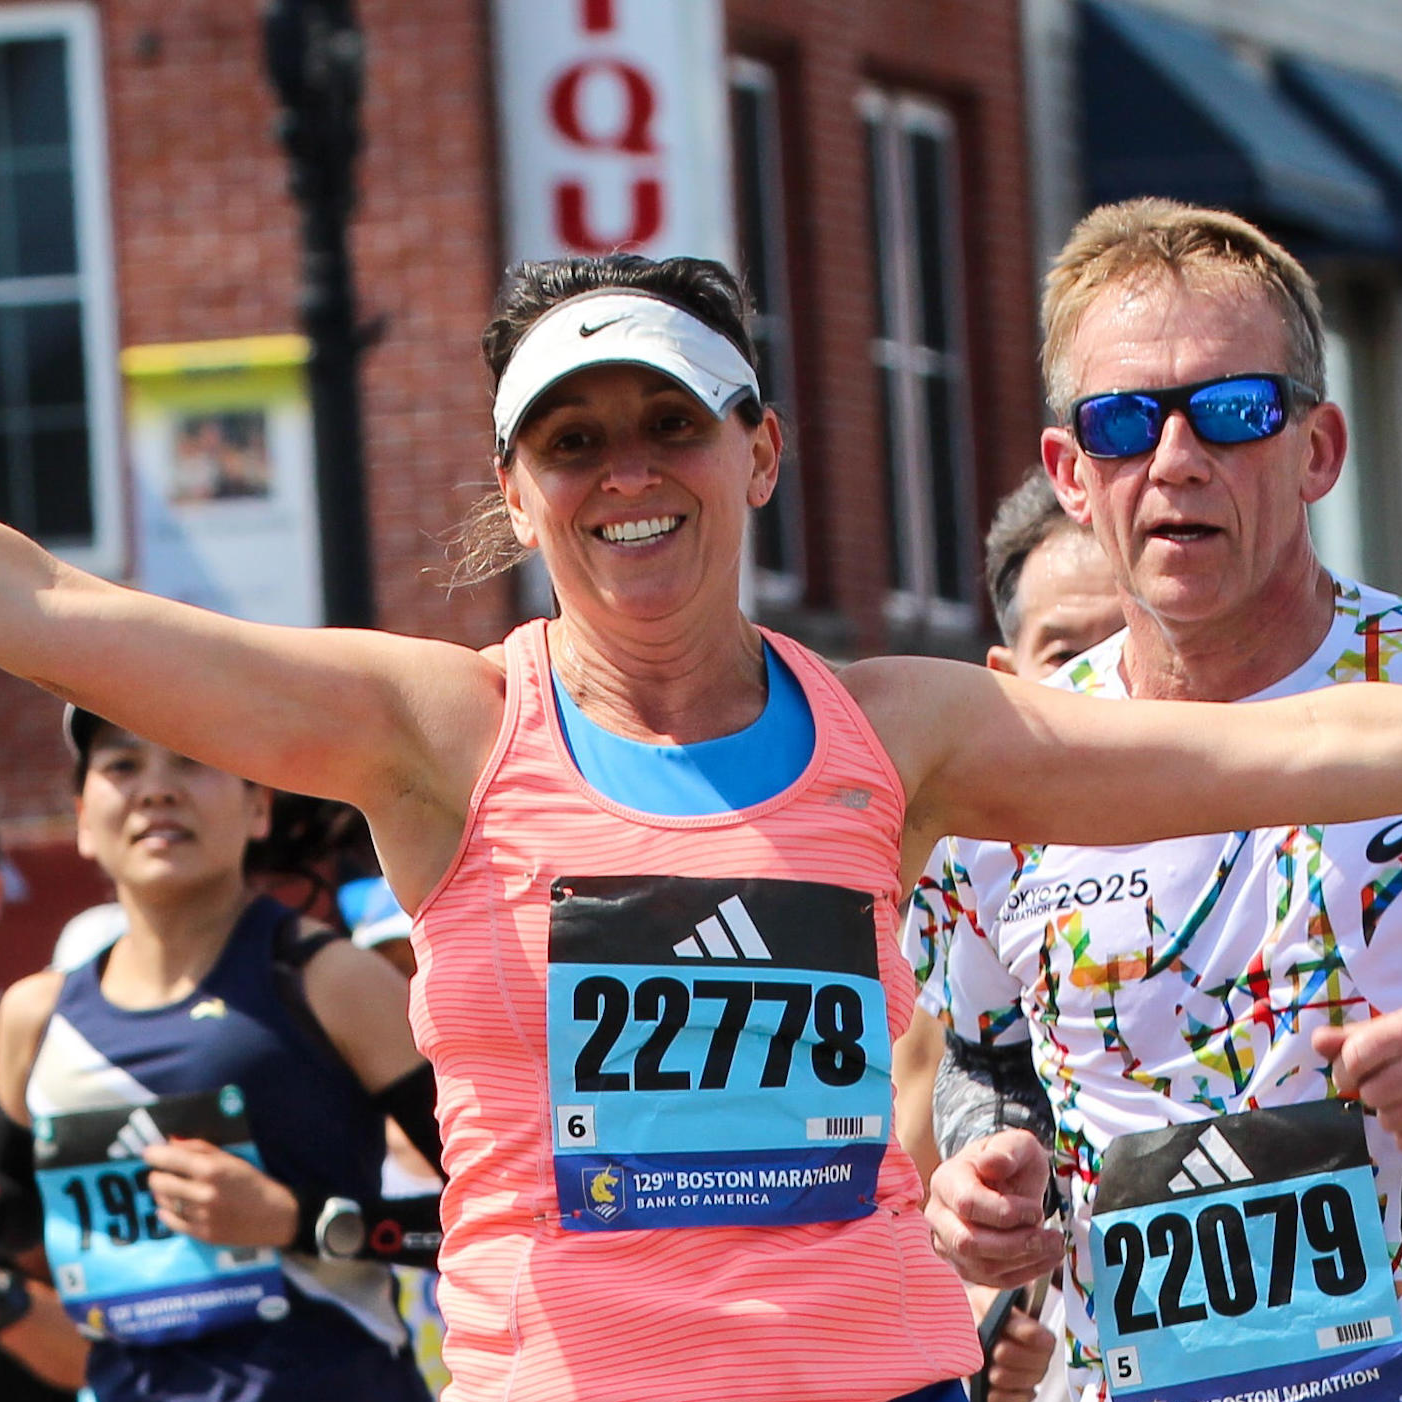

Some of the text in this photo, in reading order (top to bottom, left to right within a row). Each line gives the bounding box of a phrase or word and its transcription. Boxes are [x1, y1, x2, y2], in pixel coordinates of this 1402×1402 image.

[1002, 887, 1050, 910] OKYO
[1054, 868, 1149, 909] 2025
[573, 976, 866, 1092] 22778
[567, 1115, 587, 1138] 6
[633, 1164, 852, 1192] 129TH BOSTON MARATHON
[636, 1193, 770, 1209] BANK OF AMERICA
[1103, 1183, 1367, 1335] 22079
[1117, 1356, 1133, 1378] 5
[1282, 1367, 1381, 1402] MARATHON
